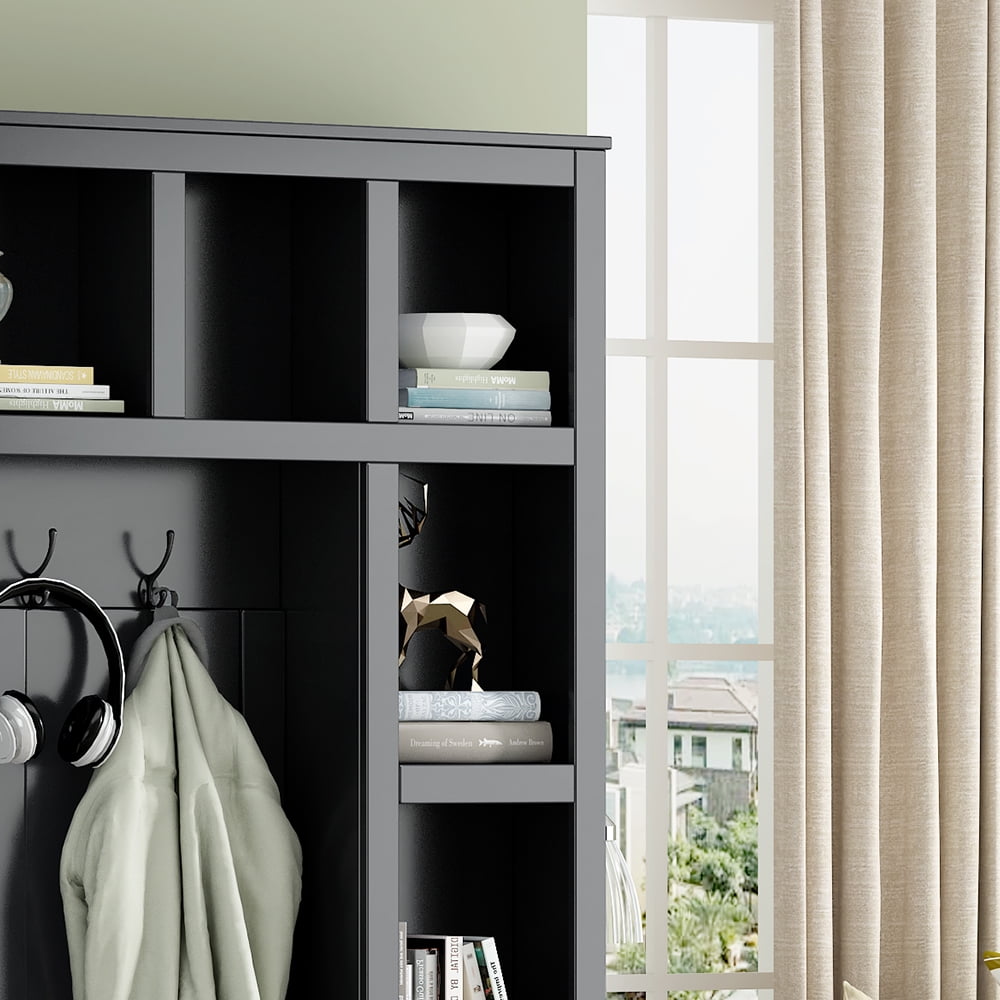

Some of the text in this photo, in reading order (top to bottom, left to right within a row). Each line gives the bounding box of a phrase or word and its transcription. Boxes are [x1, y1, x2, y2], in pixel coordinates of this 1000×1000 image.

[8, 368, 26, 380] STYLE
[456, 375, 516, 384] MoMA Highlights
[9, 398, 84, 410] MoMA Highlights
[499, 413, 516, 423] ON
[410, 738, 440, 748] Dreaming
[447, 738, 473, 747] Sweden
